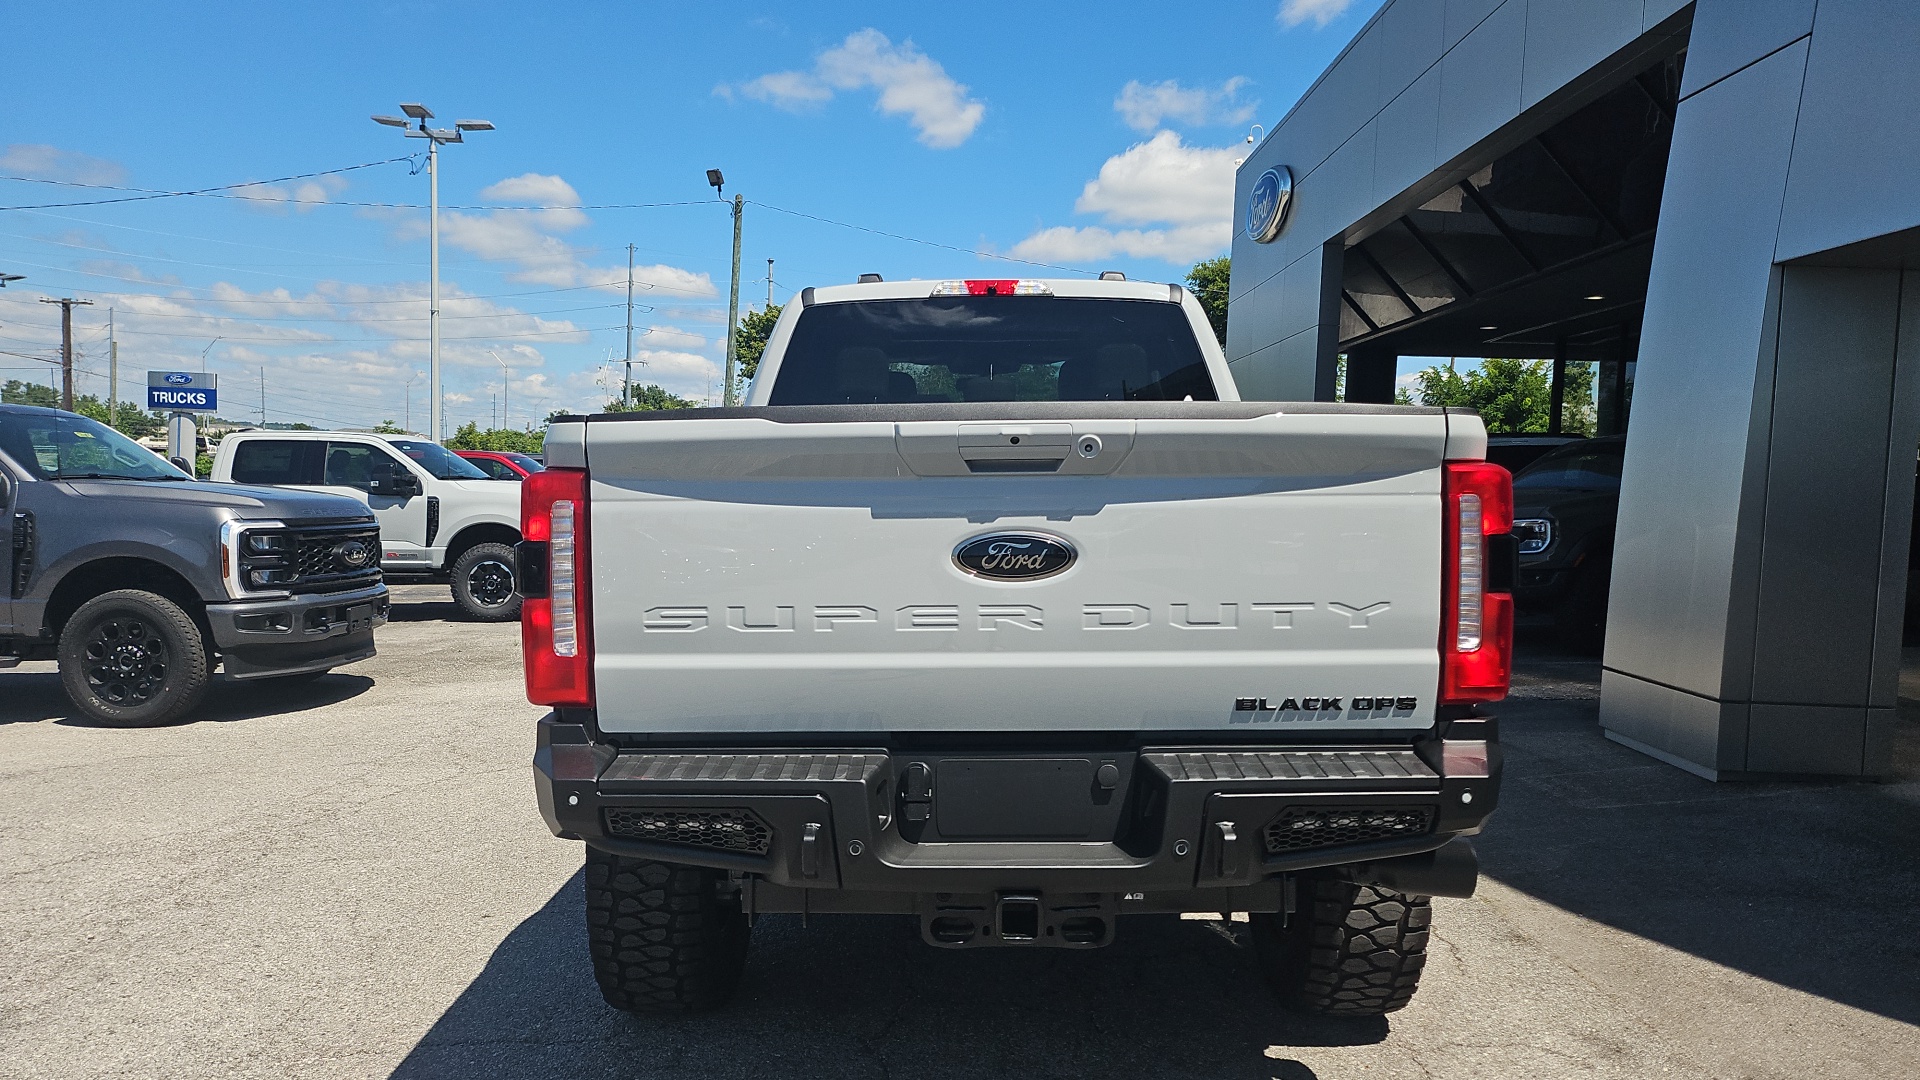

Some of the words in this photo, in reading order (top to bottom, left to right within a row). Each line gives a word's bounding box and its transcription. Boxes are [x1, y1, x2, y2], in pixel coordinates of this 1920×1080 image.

[1249, 186, 1271, 230] Ford
[168, 375, 186, 383] Ford
[152, 391, 207, 405] TRUCKS
[981, 541, 1048, 569] Ford
[643, 604, 1044, 632] SUPER
[1082, 602, 1391, 630] DUTY
[1235, 696, 1344, 711] BLACK
[1351, 696, 1417, 711] OPS
